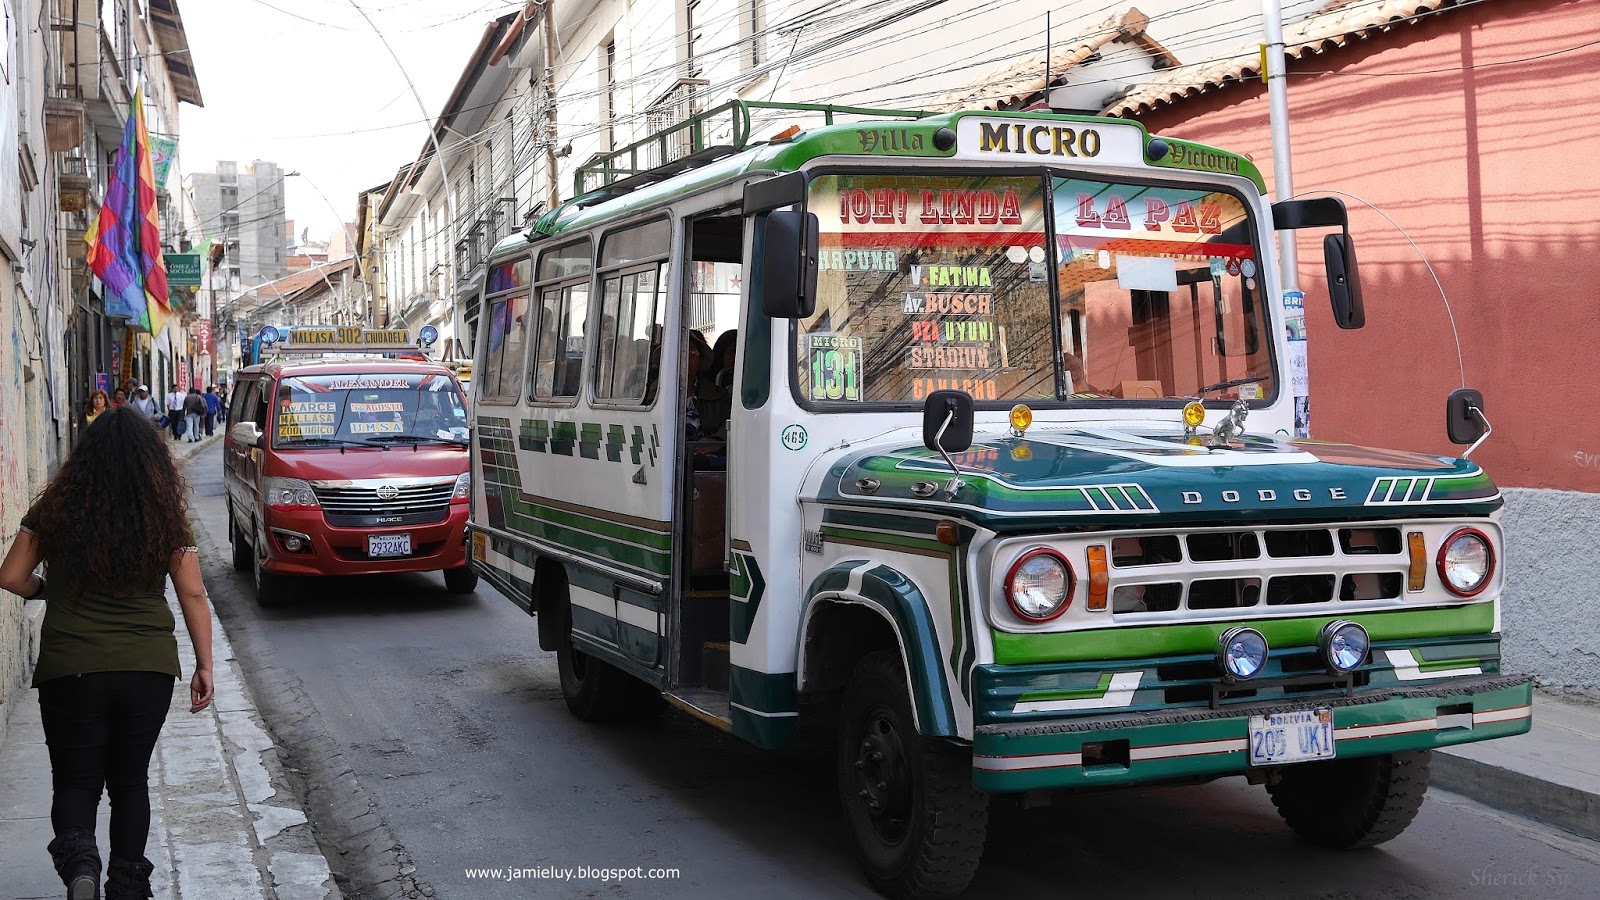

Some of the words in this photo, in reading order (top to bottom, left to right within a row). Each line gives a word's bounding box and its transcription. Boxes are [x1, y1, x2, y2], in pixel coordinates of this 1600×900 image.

[856, 129, 924, 153] Villa
[980, 122, 1101, 159] MICRO
[1168, 142, 1239, 173] Victoria
[919, 188, 1022, 225] LINDA
[1075, 193, 1131, 230] LA
[1143, 197, 1222, 235] PAZ
[291, 331, 334, 344] MALLASA
[339, 327, 362, 345] 902
[365, 331, 409, 344] CIUDADELA
[813, 336, 857, 348] MICRO
[812, 349, 859, 400] 131
[329, 379, 410, 390] ALEXANDER
[280, 414, 333, 424] MALLASA
[784, 431, 805, 444] 469
[1182, 487, 1347, 504] DODGE
[371, 541, 409, 555] 2932AKC
[1270, 714, 1312, 726] BOLIVIA
[1254, 728, 1287, 758] 205
